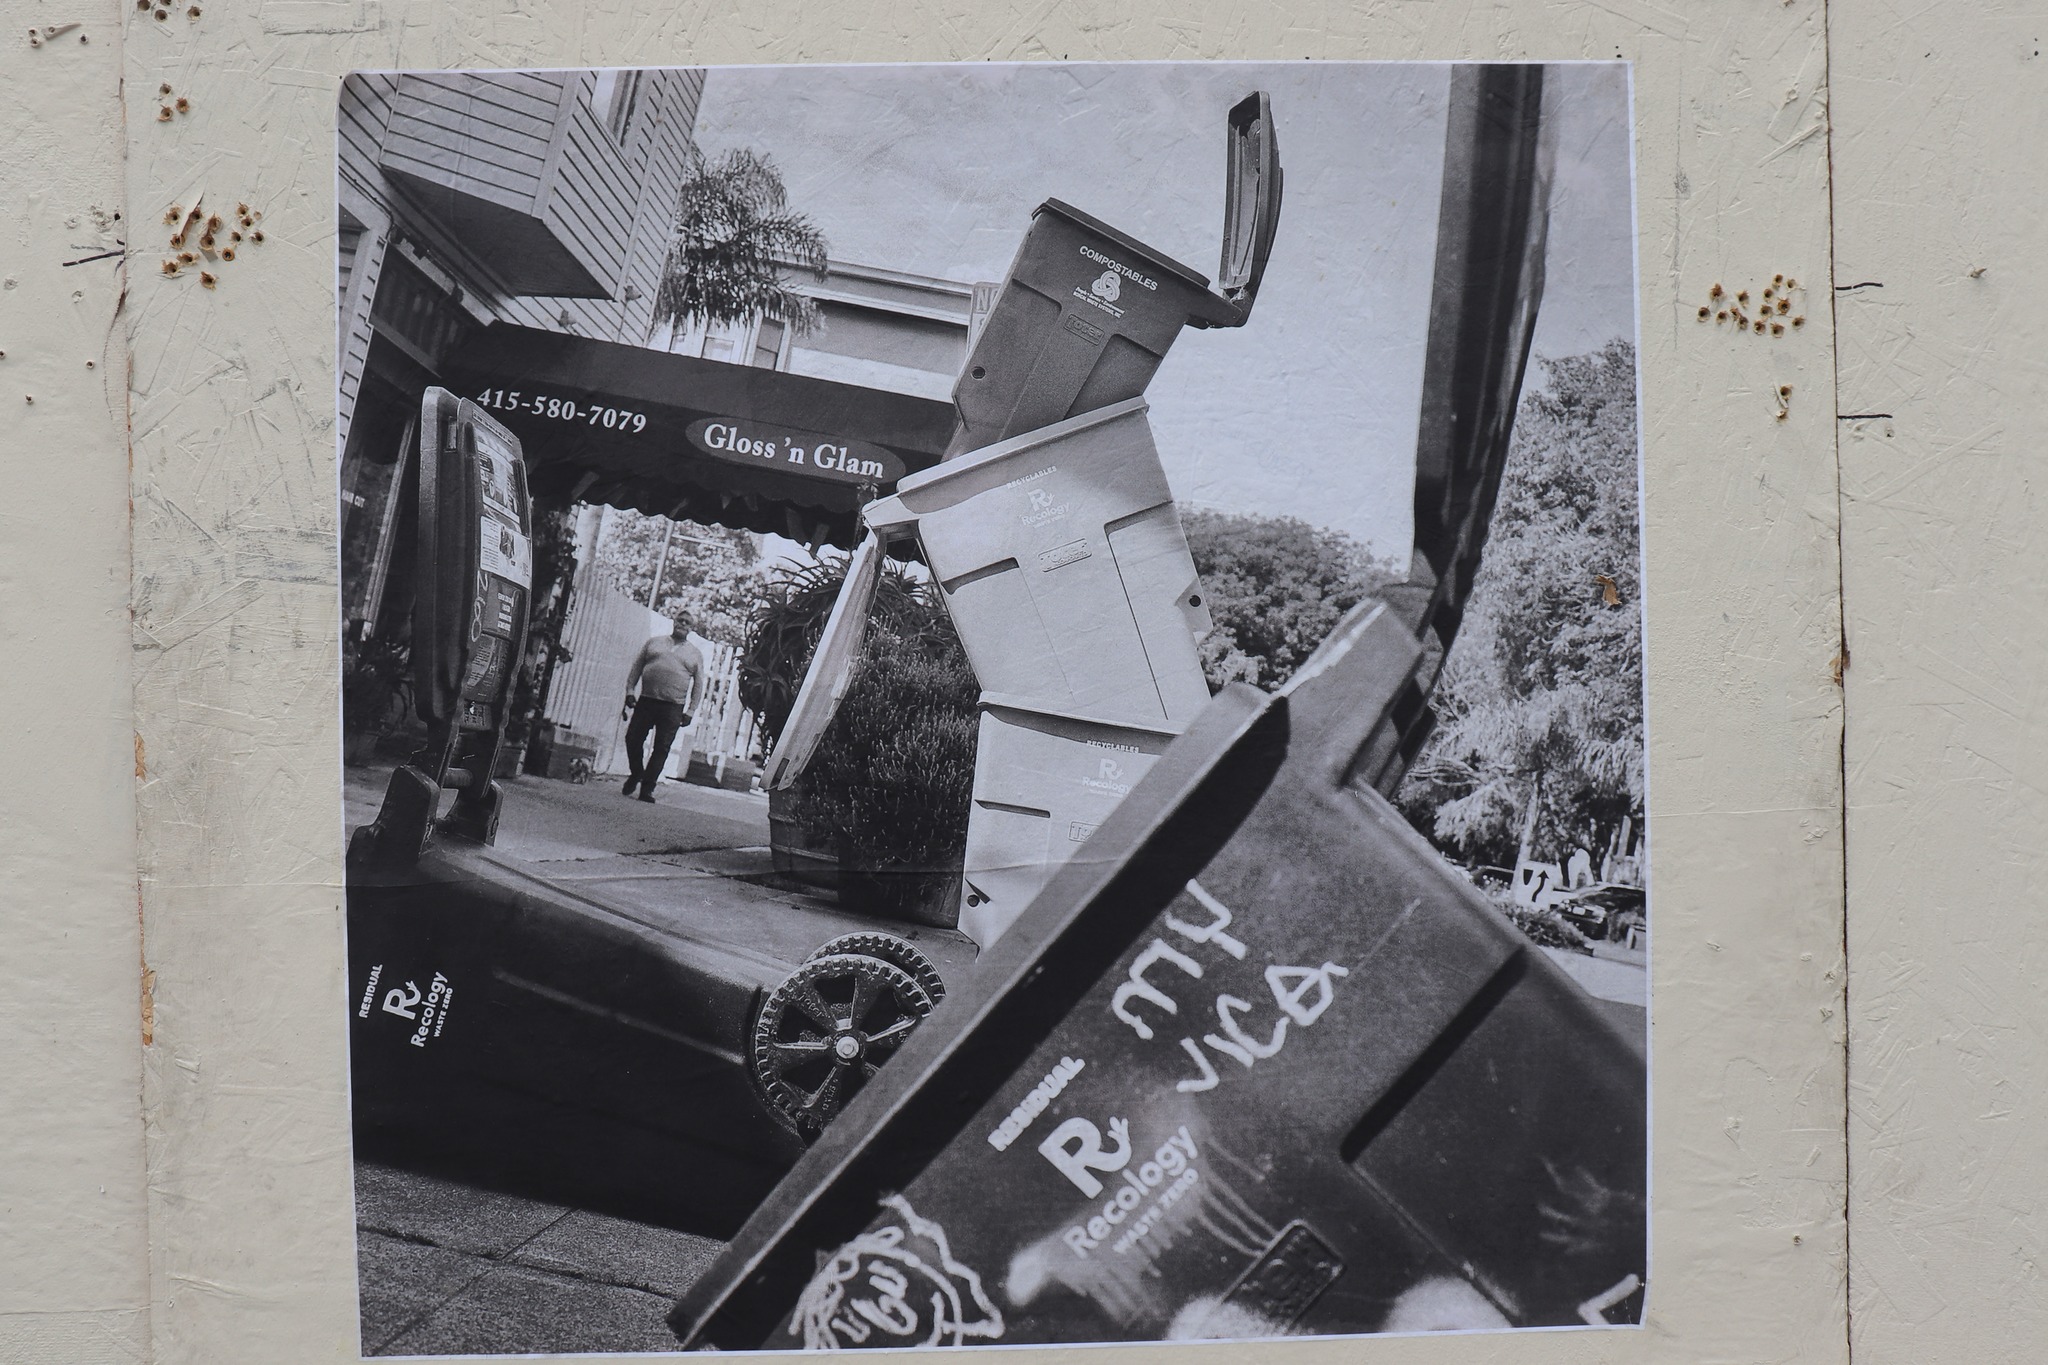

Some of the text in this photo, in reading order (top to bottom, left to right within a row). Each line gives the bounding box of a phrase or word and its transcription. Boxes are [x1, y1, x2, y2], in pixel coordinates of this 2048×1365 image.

[1080, 246, 1158, 291] COMPOSTABLES
[477, 388, 647, 434] 415-580-7079
[704, 423, 776, 459] Gloss
[813, 443, 884, 479] Glam
[1007, 465, 1057, 489] RECYCLABLES
[1021, 502, 1070, 525] Recology
[1086, 740, 1140, 753] RECYCLABLES
[359, 964, 383, 1018] RESIDUAL
[410, 971, 448, 1047] Recology
[433, 987, 453, 1037] WASTE ZERO
[1063, 1126, 1198, 1259] Recology
